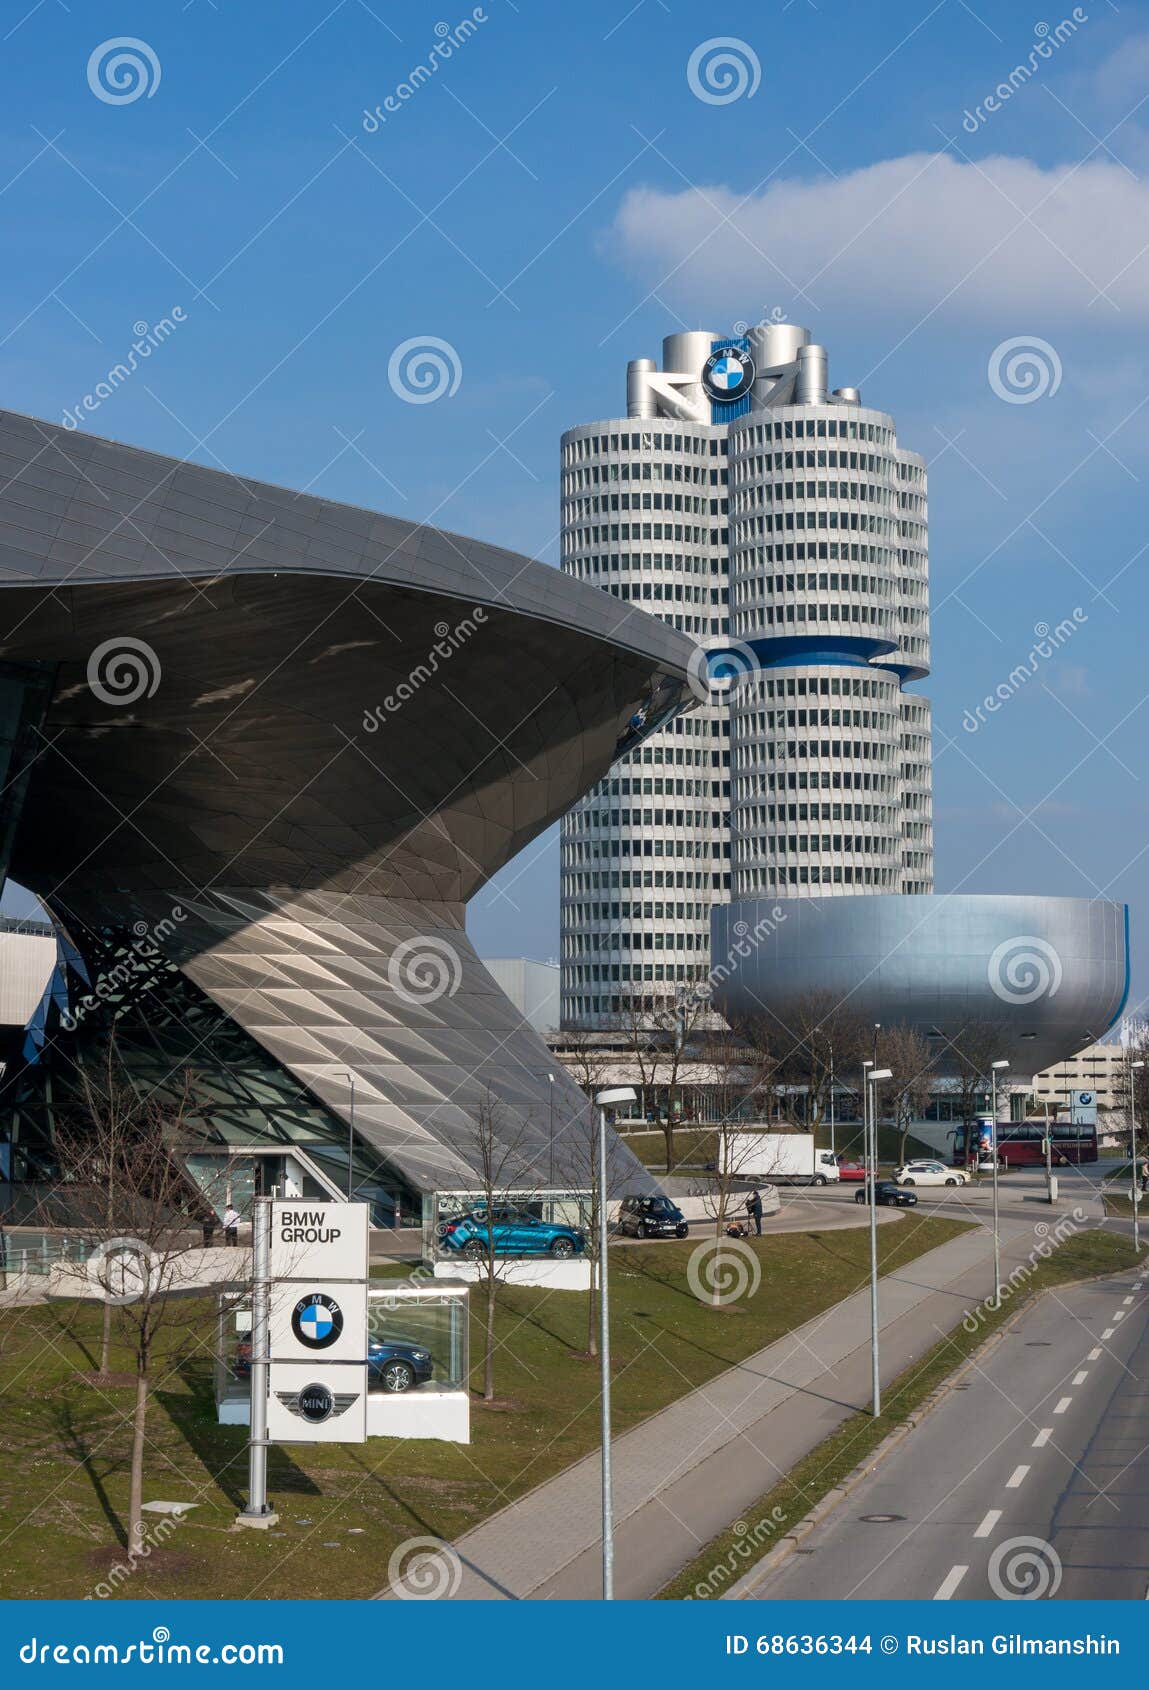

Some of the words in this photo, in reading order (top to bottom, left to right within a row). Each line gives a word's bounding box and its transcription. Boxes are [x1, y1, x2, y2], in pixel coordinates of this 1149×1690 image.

[281, 1211, 326, 1227] BMW
[281, 1228, 342, 1243] GROUP
[303, 1398, 329, 1410] MINI
